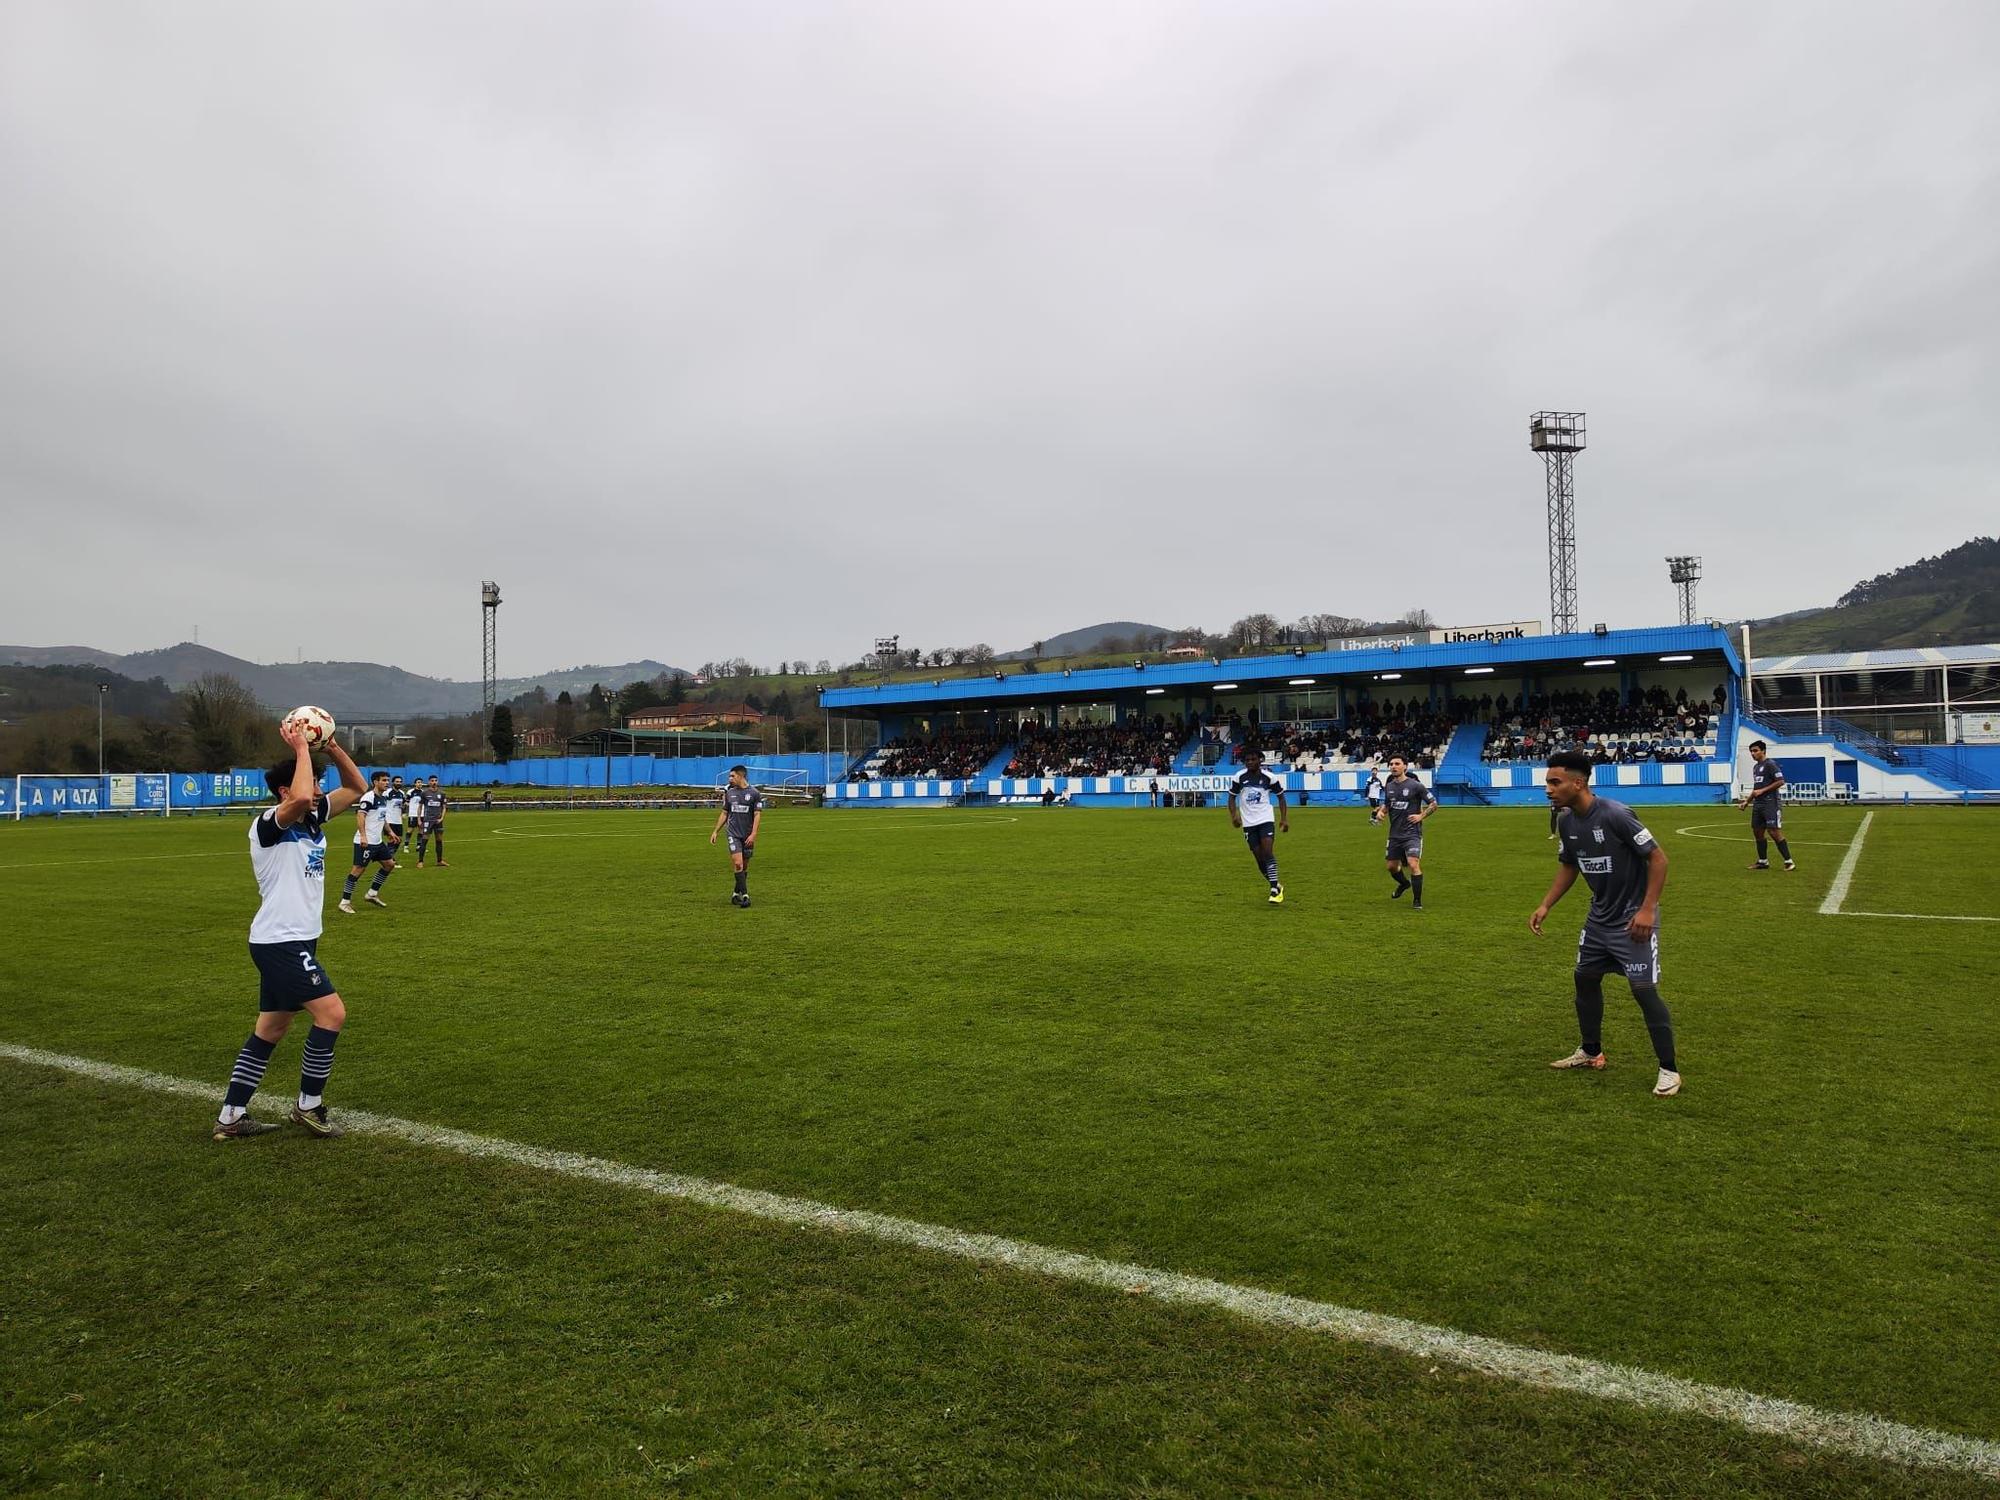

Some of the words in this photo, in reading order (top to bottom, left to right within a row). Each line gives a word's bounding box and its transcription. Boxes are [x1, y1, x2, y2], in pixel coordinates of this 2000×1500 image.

[1340, 635, 1416, 652] Liberbank
[1444, 626, 1524, 644] Liberbank
[214, 775, 247, 786] ERBI
[1168, 777, 1233, 791] MOSCON
[299, 951, 317, 972] 2
